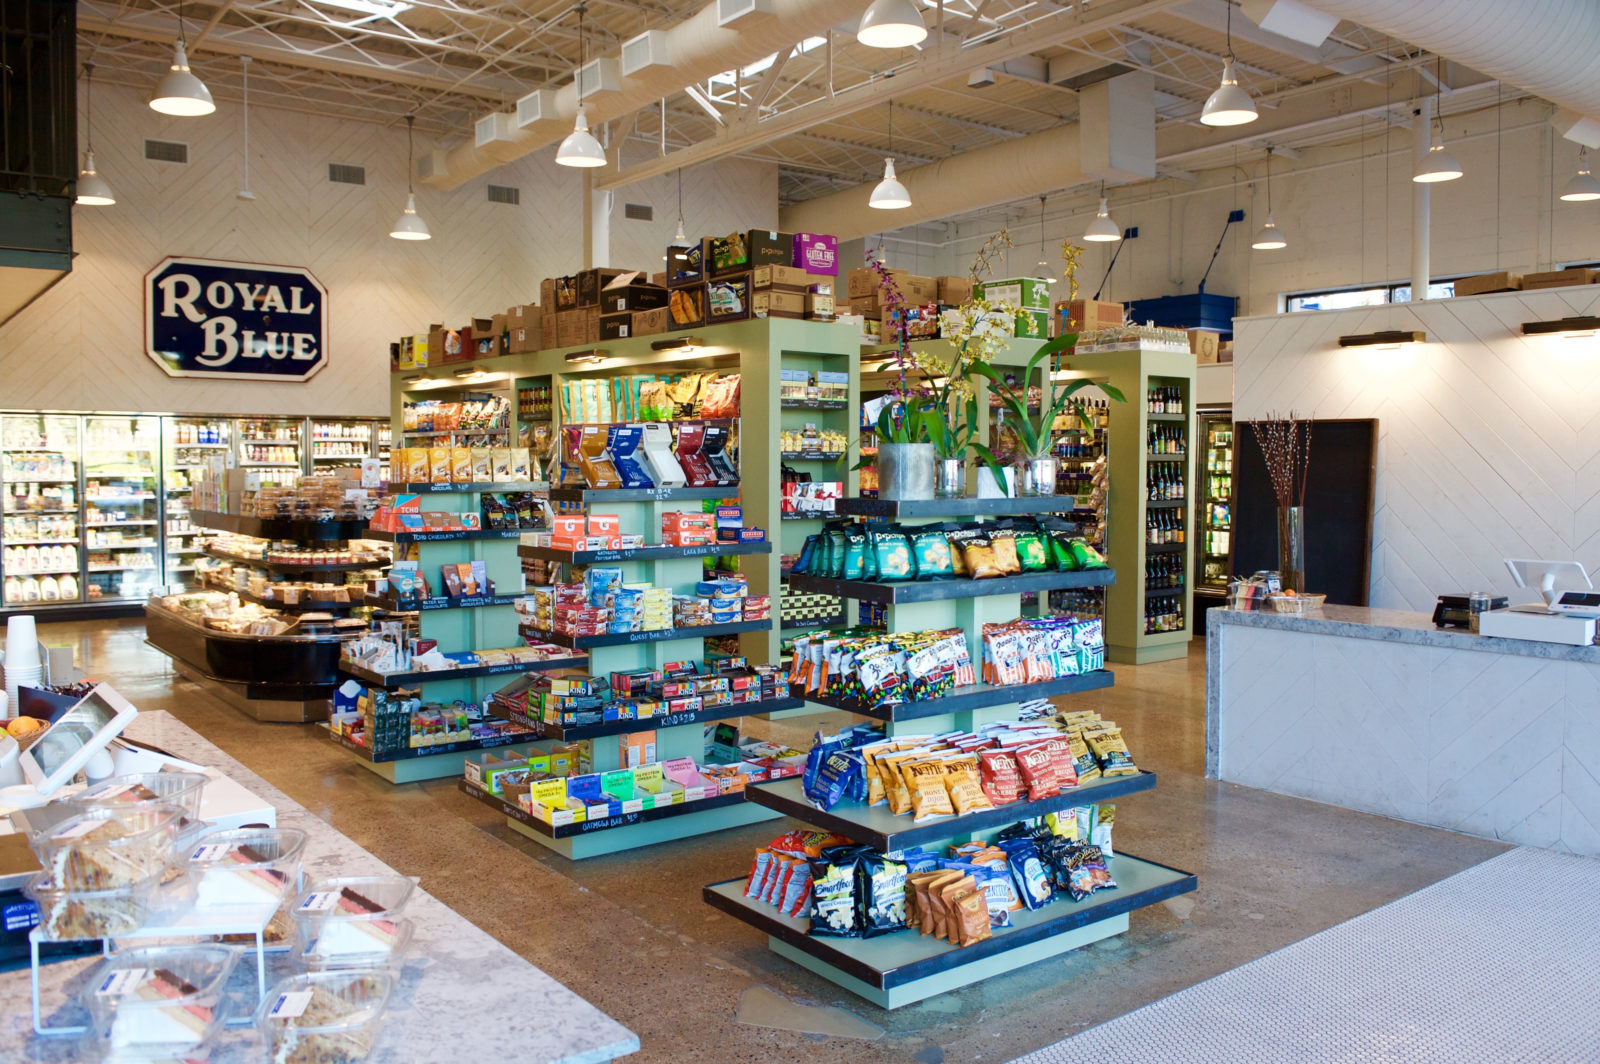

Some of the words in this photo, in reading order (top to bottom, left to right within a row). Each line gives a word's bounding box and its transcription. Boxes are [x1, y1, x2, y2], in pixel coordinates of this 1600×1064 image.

[158, 273, 315, 323] ROYAL
[195, 315, 318, 367] BLUE
[401, 506, 419, 514] TCHO
[564, 518, 576, 532] G
[599, 517, 611, 531] G
[679, 517, 689, 529] G
[681, 532, 691, 545] G
[876, 533, 907, 542] popchips
[576, 540, 585, 551] G
[611, 539, 621, 550] G
[630, 633, 648, 641] QUEST
[661, 715, 679, 726] KIND
[582, 821, 610, 831] OATMEGA
[610, 818, 623, 828] BAR
